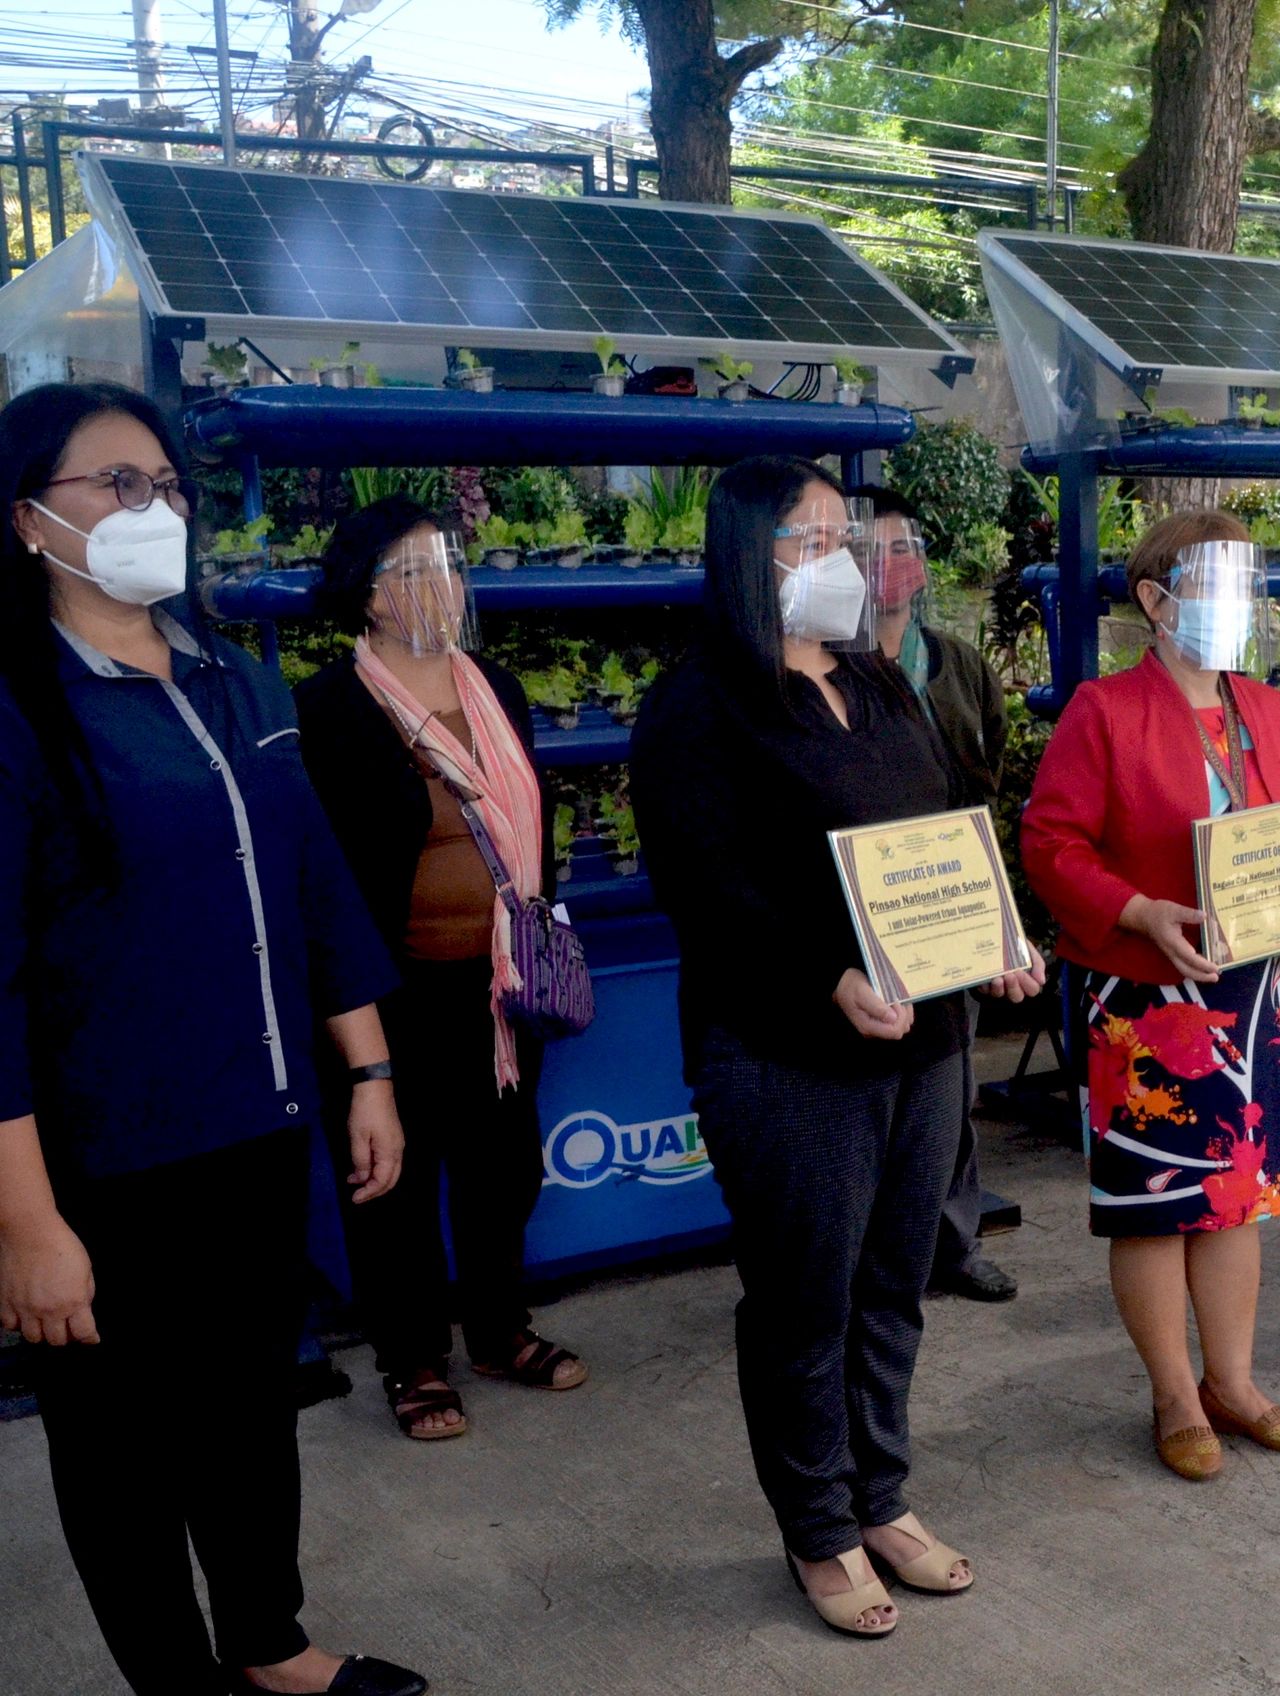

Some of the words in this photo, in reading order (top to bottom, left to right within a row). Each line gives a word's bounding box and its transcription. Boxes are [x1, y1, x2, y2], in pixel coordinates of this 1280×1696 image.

[1232, 848, 1272, 867] CERTIFICATE
[883, 866, 927, 886] CERTIFICATE
[926, 863, 936, 878] OF
[937, 859, 962, 875] AWARD
[1249, 868, 1276, 881] National
[868, 898, 901, 913] Pinsao
[902, 887, 941, 907] National
[941, 882, 962, 899] High
[962, 877, 992, 893] School
[903, 910, 941, 927] Solar-Powered
